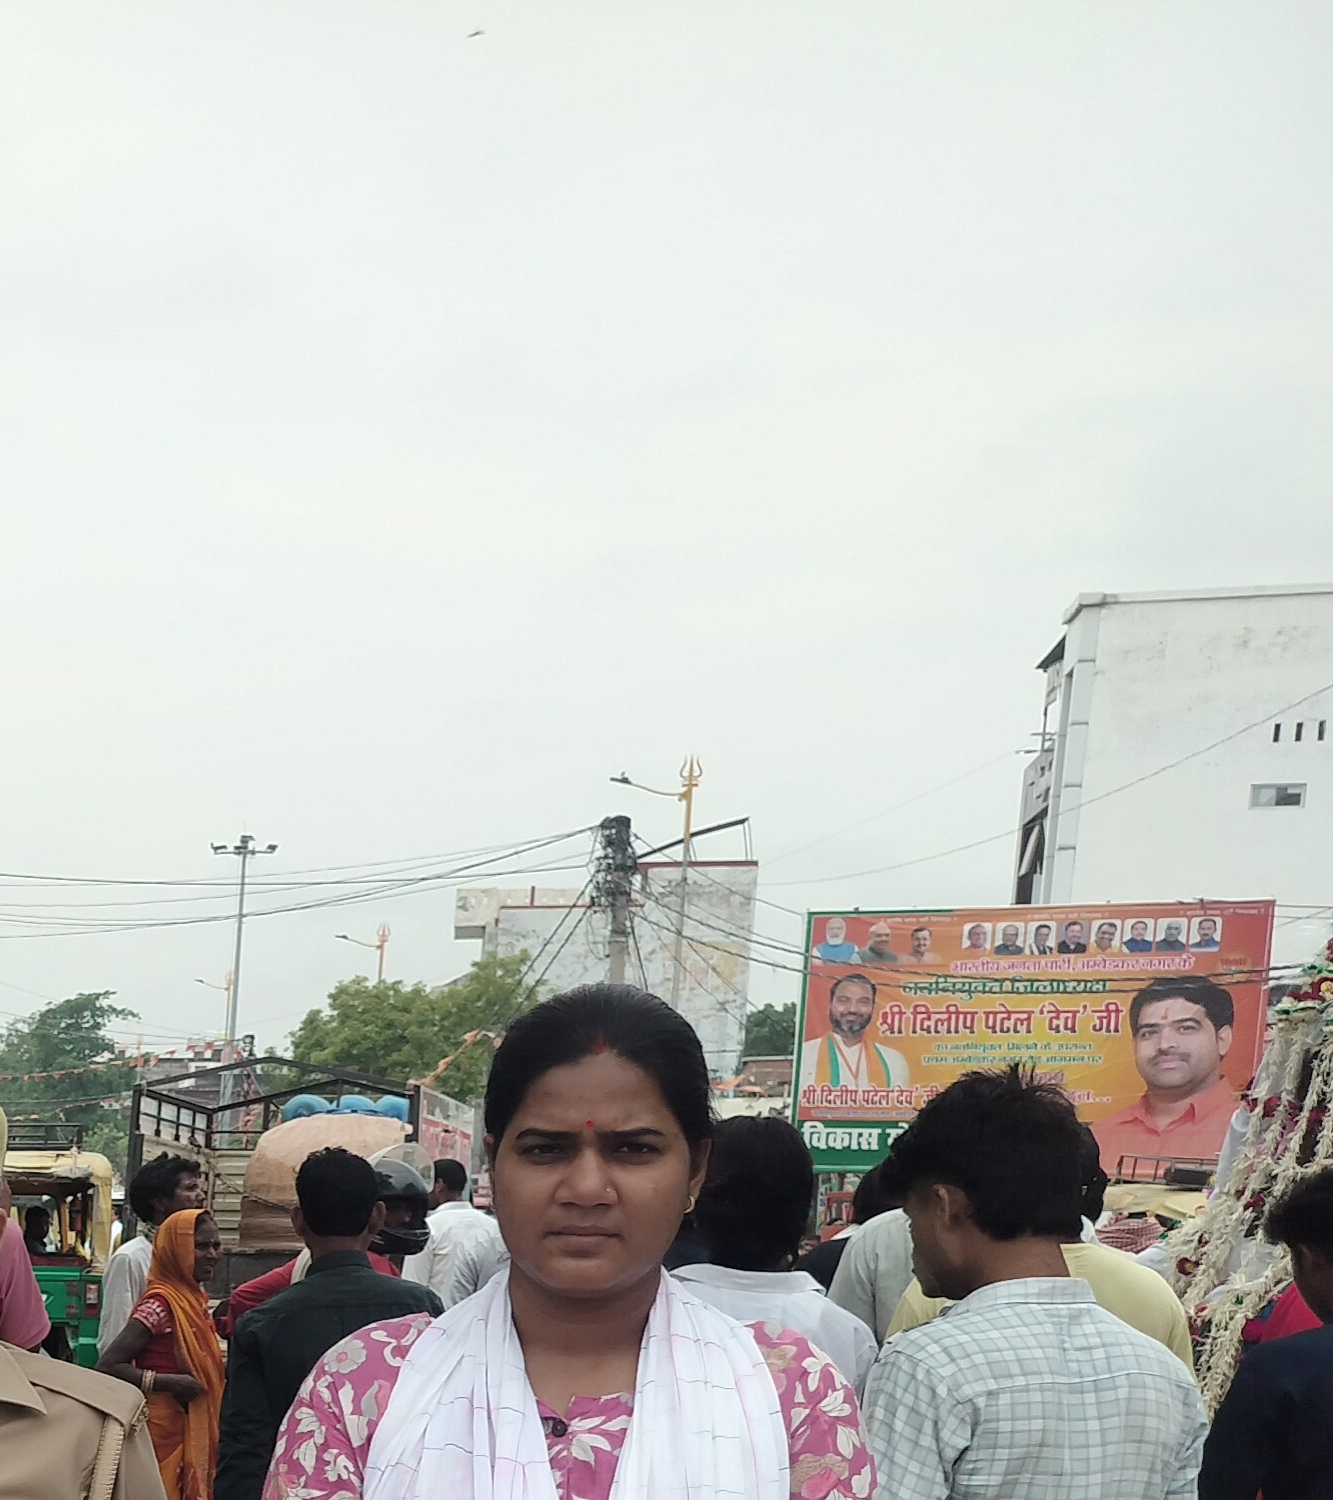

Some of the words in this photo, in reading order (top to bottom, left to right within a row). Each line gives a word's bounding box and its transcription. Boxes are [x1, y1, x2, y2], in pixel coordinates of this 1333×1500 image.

[879, 1003, 906, 1035] श्री
[911, 1001, 979, 1035] दिलीप
[984, 1002, 1035, 1035] पटेल
[1091, 1001, 1124, 1034] जी
[801, 1084, 817, 1106] श्री
[820, 1083, 858, 1107] दिलीप
[862, 1085, 891, 1106] पटेल
[800, 1120, 883, 1150] विकास
